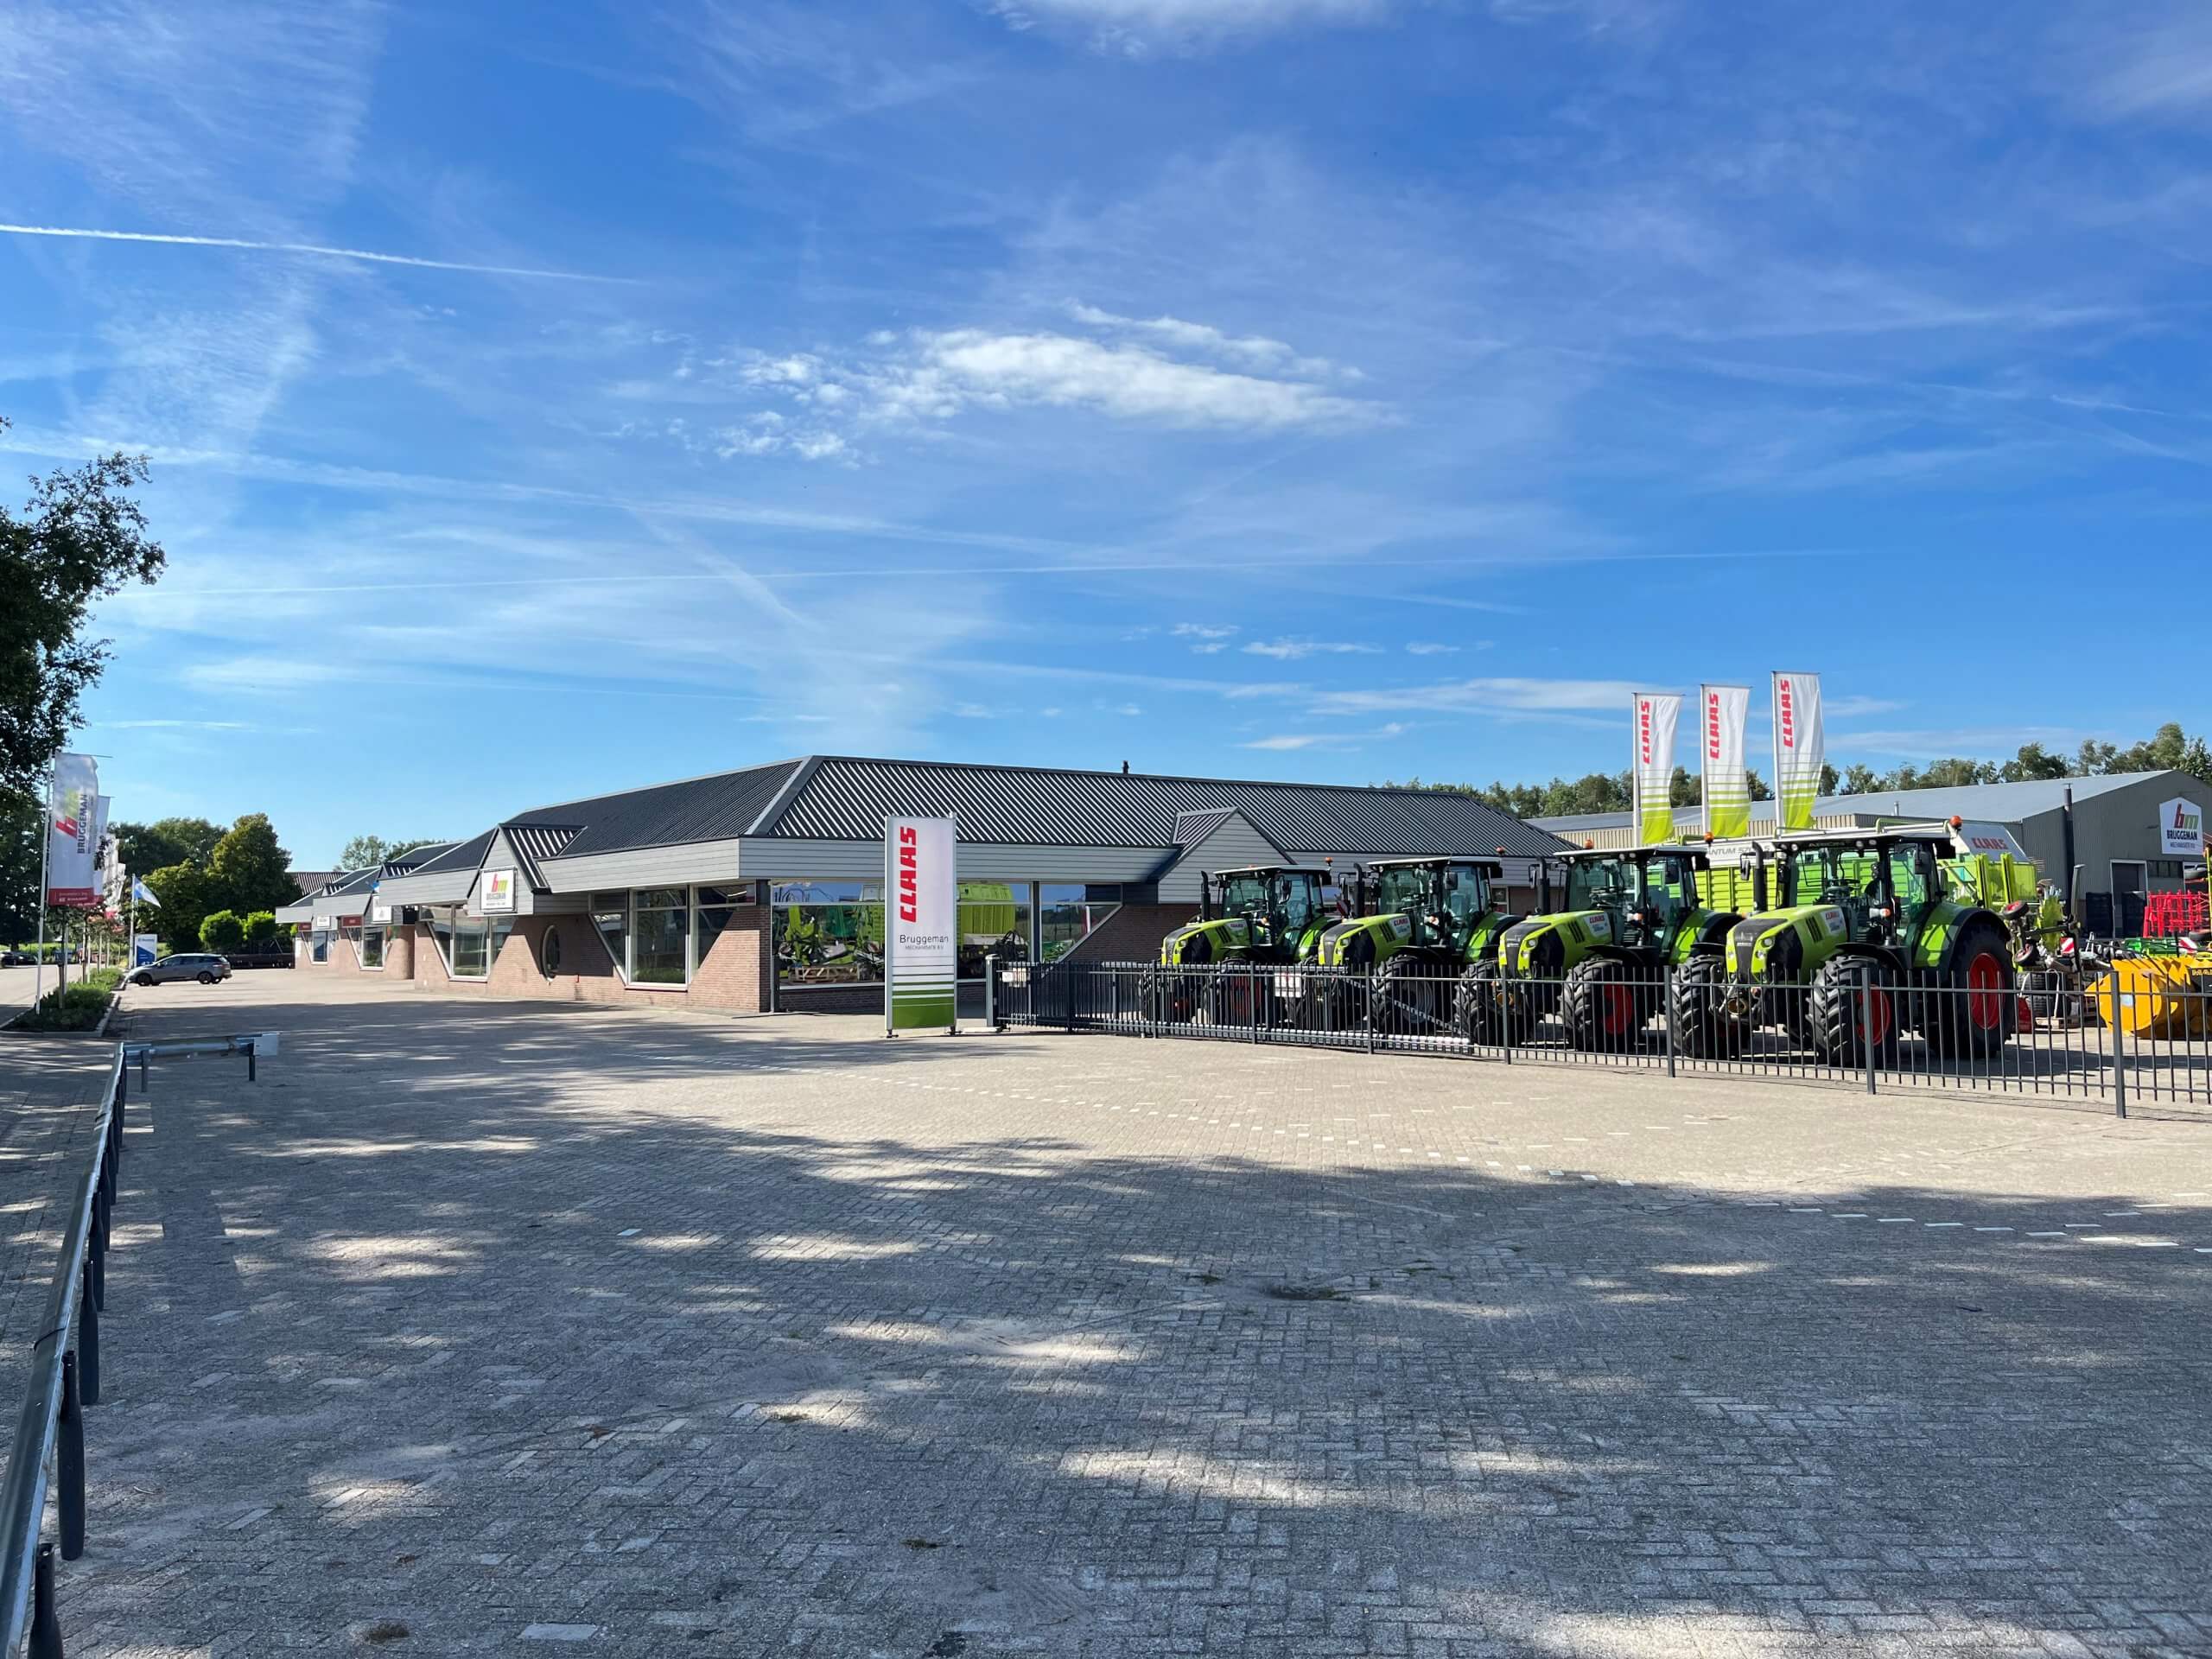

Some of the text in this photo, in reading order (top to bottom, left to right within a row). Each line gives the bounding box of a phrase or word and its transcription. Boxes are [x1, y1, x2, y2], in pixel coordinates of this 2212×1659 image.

[1641, 701, 1650, 765] CLAAS
[1709, 693, 1719, 760] CLAAS
[1780, 679, 1794, 747] CLAAS
[77, 794, 89, 854] BRUGGEMAN
[1971, 837, 2009, 849] CLAAS
[2167, 830, 2197, 840] BRUGGEMAN
[900, 826, 917, 923] CLAAS
[899, 934, 949, 945] Bruggeman
